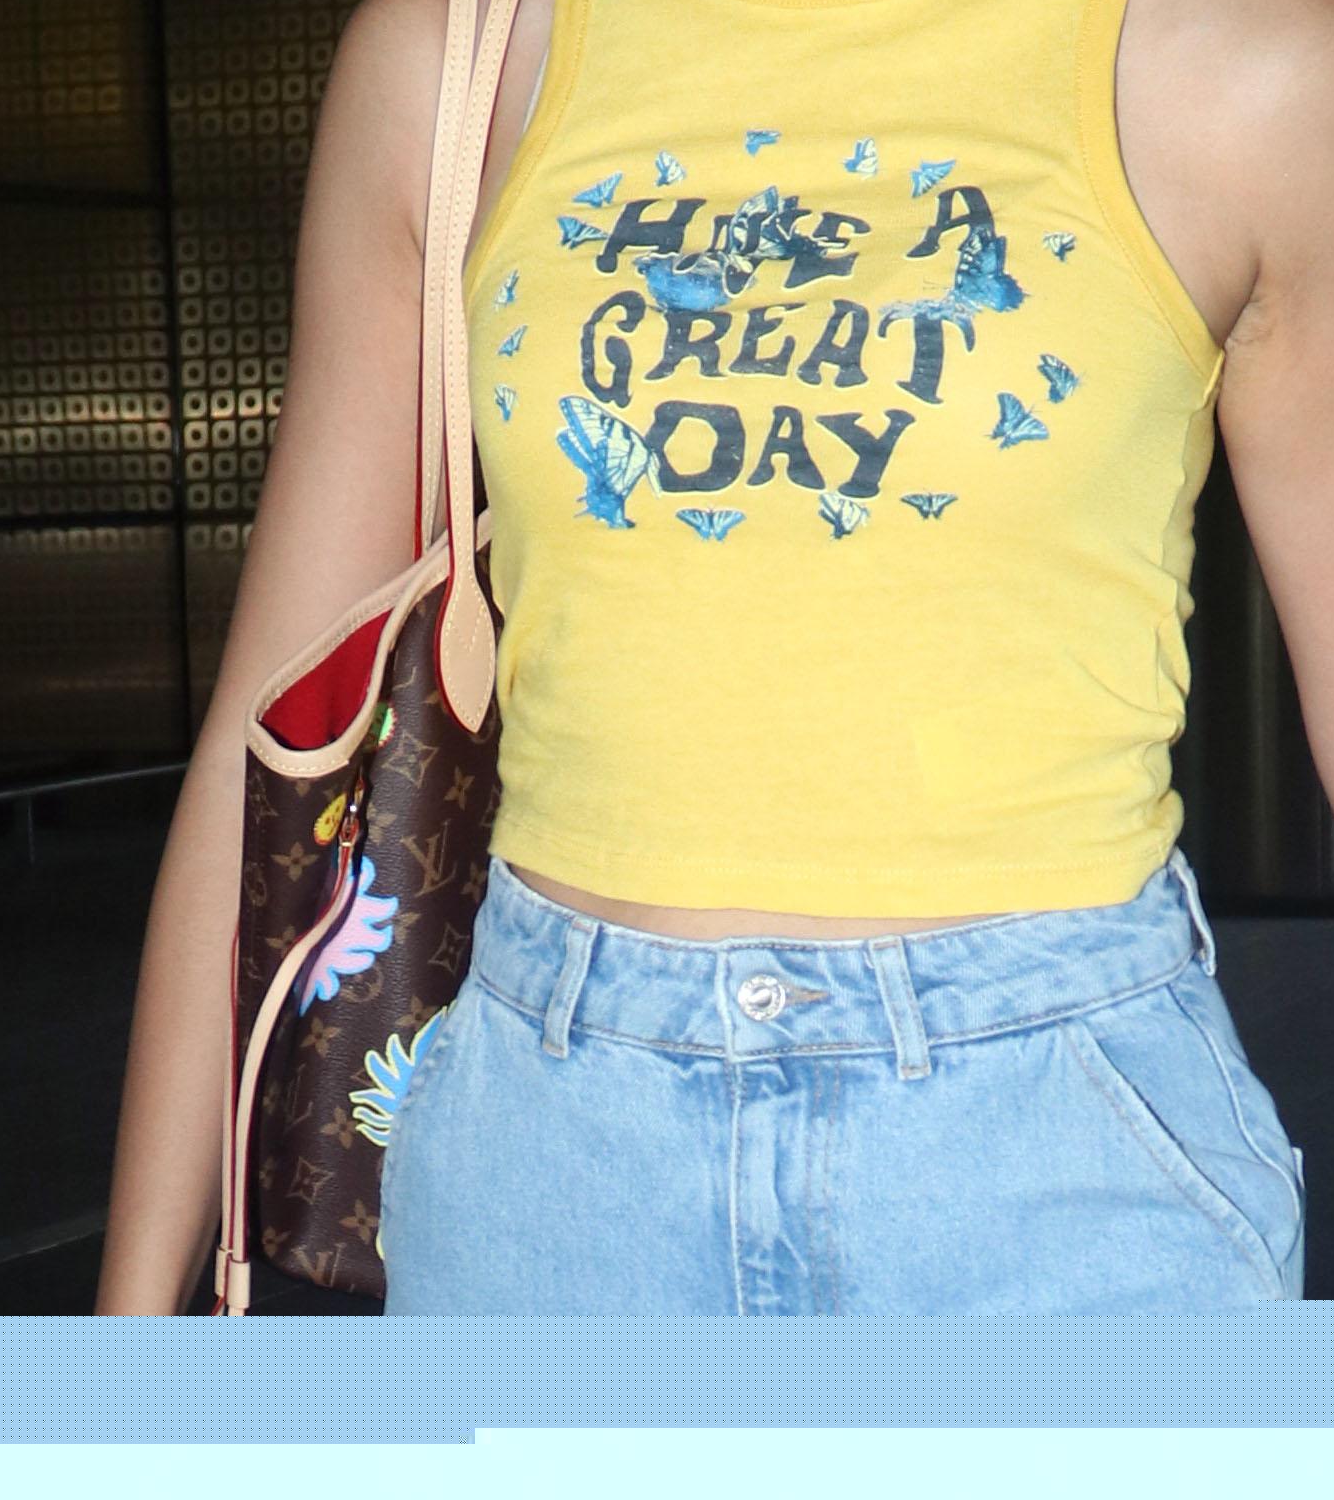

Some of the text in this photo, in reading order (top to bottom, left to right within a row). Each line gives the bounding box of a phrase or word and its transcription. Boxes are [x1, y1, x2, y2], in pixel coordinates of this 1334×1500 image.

[906, 185, 1000, 262] A
[580, 290, 976, 407] GREAT
[644, 400, 917, 499] DAY
